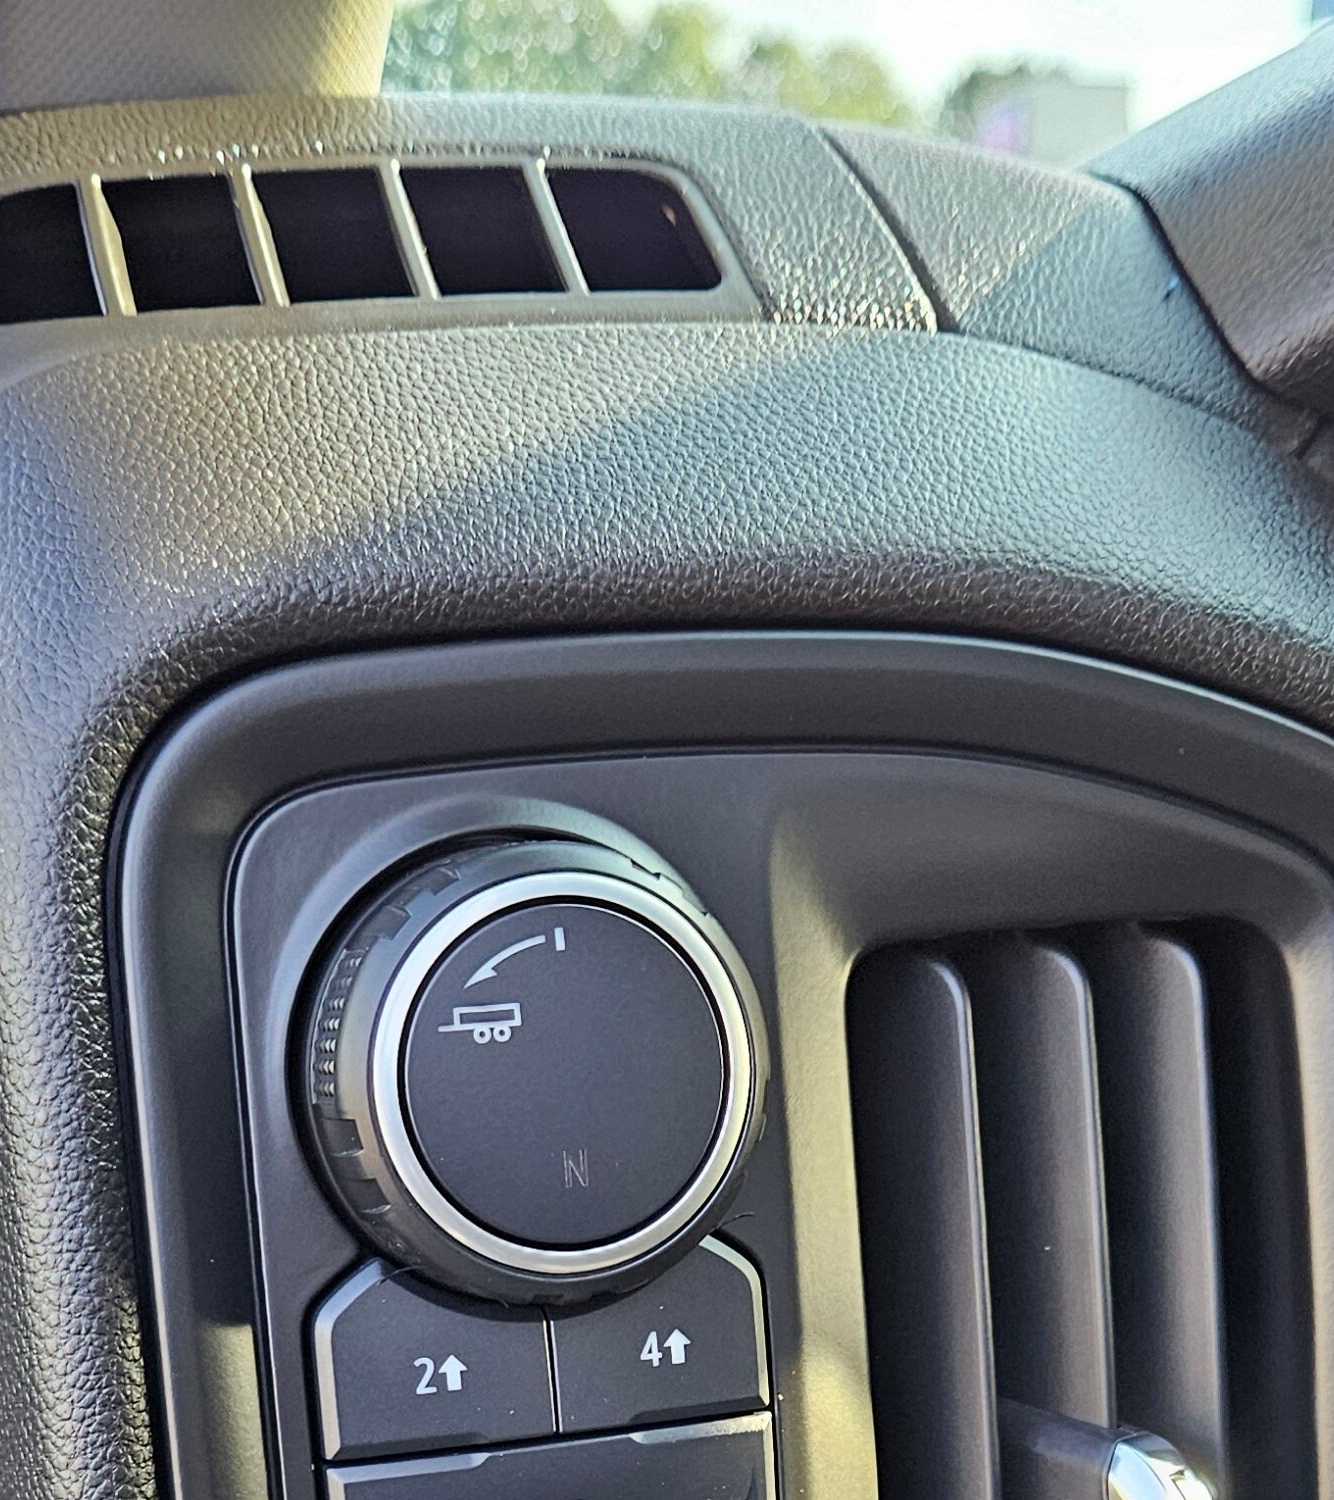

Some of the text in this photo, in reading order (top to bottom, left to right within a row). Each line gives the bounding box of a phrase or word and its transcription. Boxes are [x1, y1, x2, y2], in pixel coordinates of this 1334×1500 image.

[563, 1148, 589, 1188] N
[639, 1331, 662, 1368] 4
[413, 1357, 437, 1395] 2
